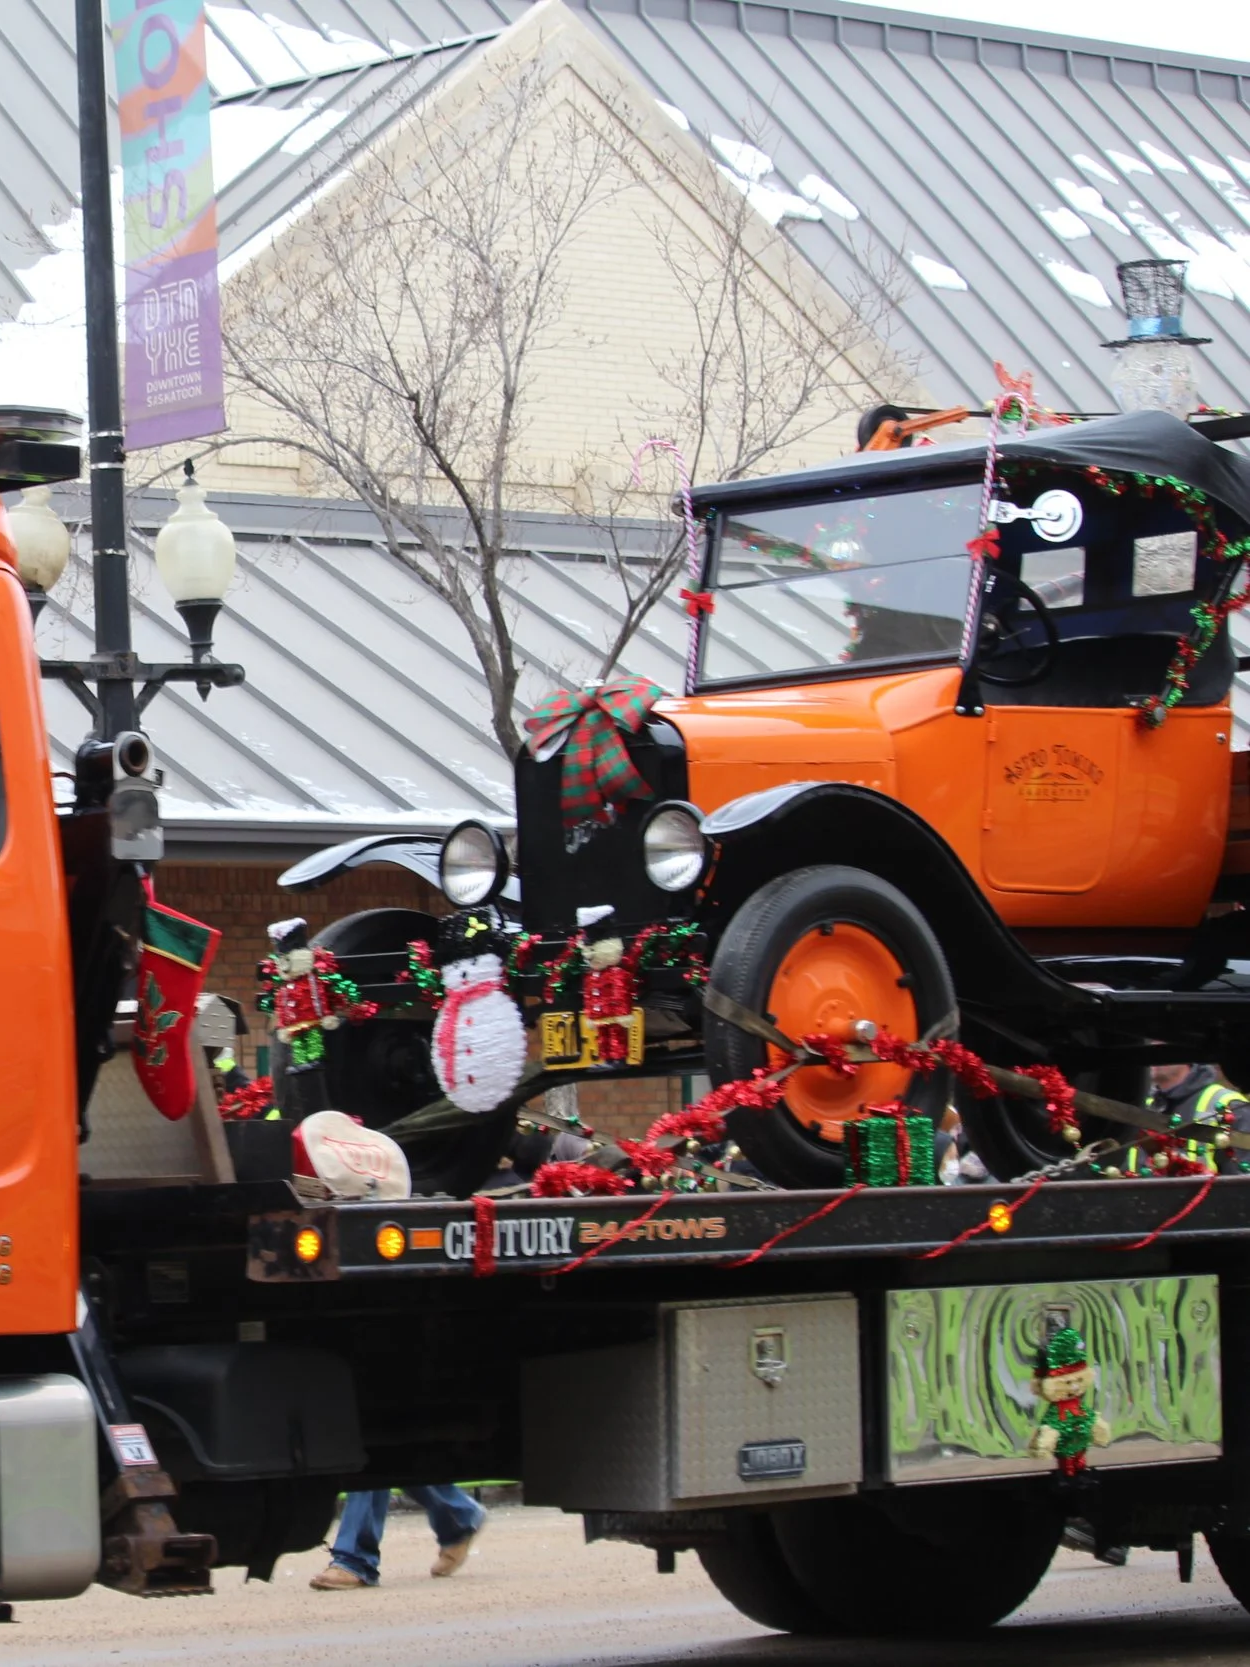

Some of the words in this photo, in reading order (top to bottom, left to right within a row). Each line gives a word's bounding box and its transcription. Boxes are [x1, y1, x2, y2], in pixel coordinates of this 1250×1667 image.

[136, 0, 189, 229] SHO
[146, 371, 202, 393] DOWNTOWN
[146, 385, 203, 407] SASKATOON
[444, 1217, 575, 1260] CETURY
